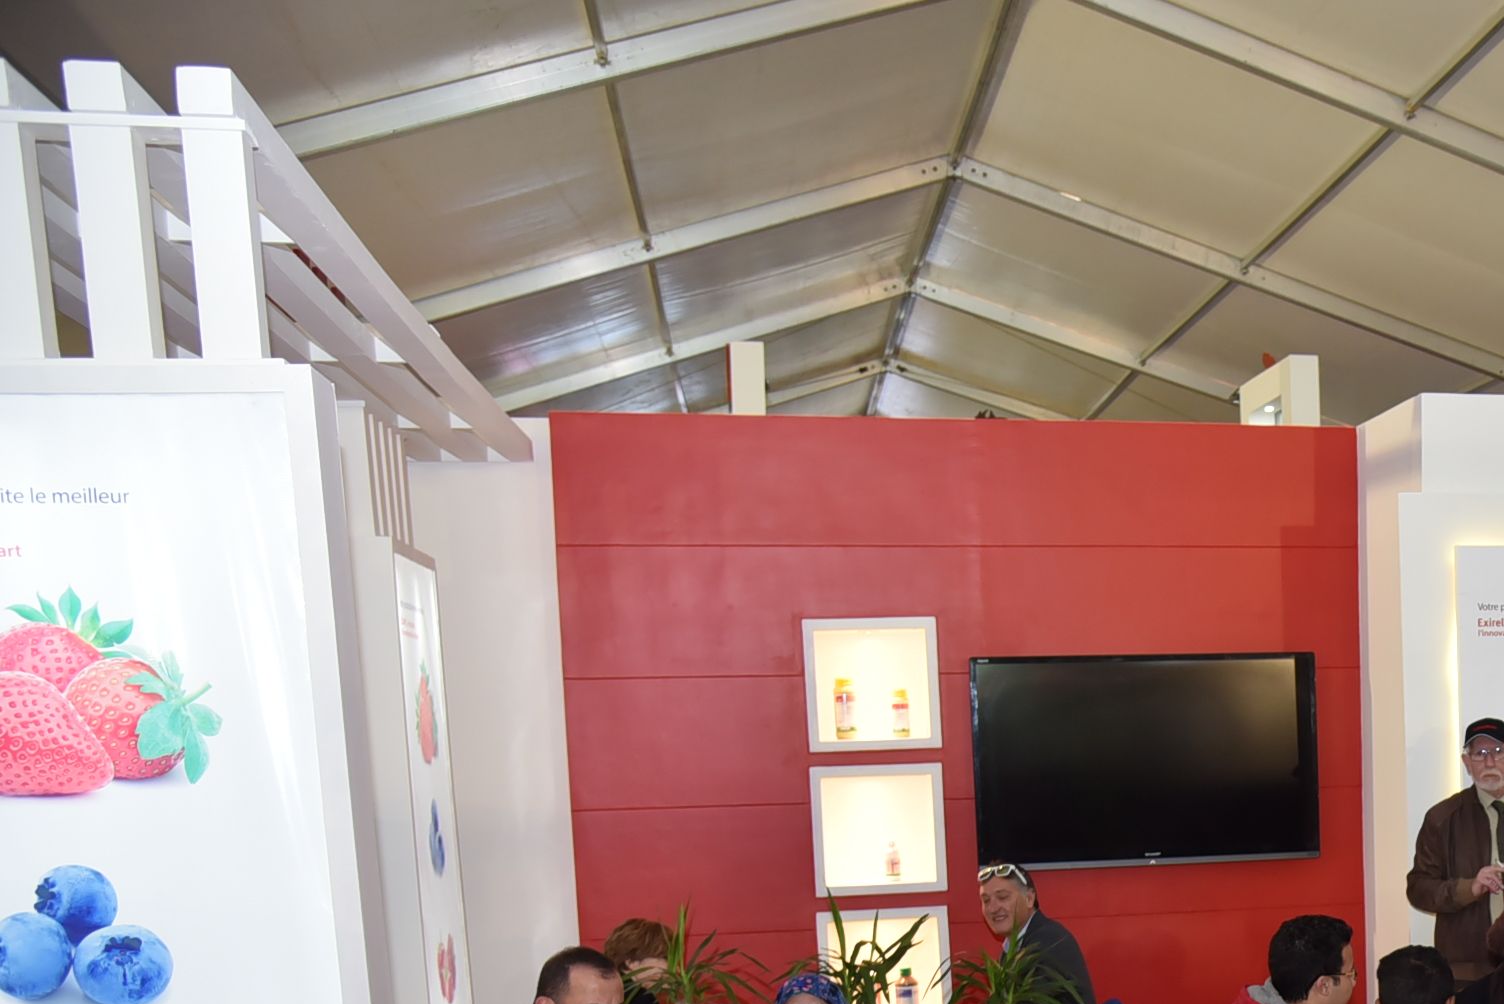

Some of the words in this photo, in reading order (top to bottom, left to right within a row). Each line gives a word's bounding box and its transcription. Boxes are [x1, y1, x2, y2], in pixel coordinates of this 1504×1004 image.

[29, 486, 47, 504] le
[52, 486, 130, 504] meilleur
[1476, 602, 1499, 611] Votre
[1477, 617, 1504, 628] Exirel
